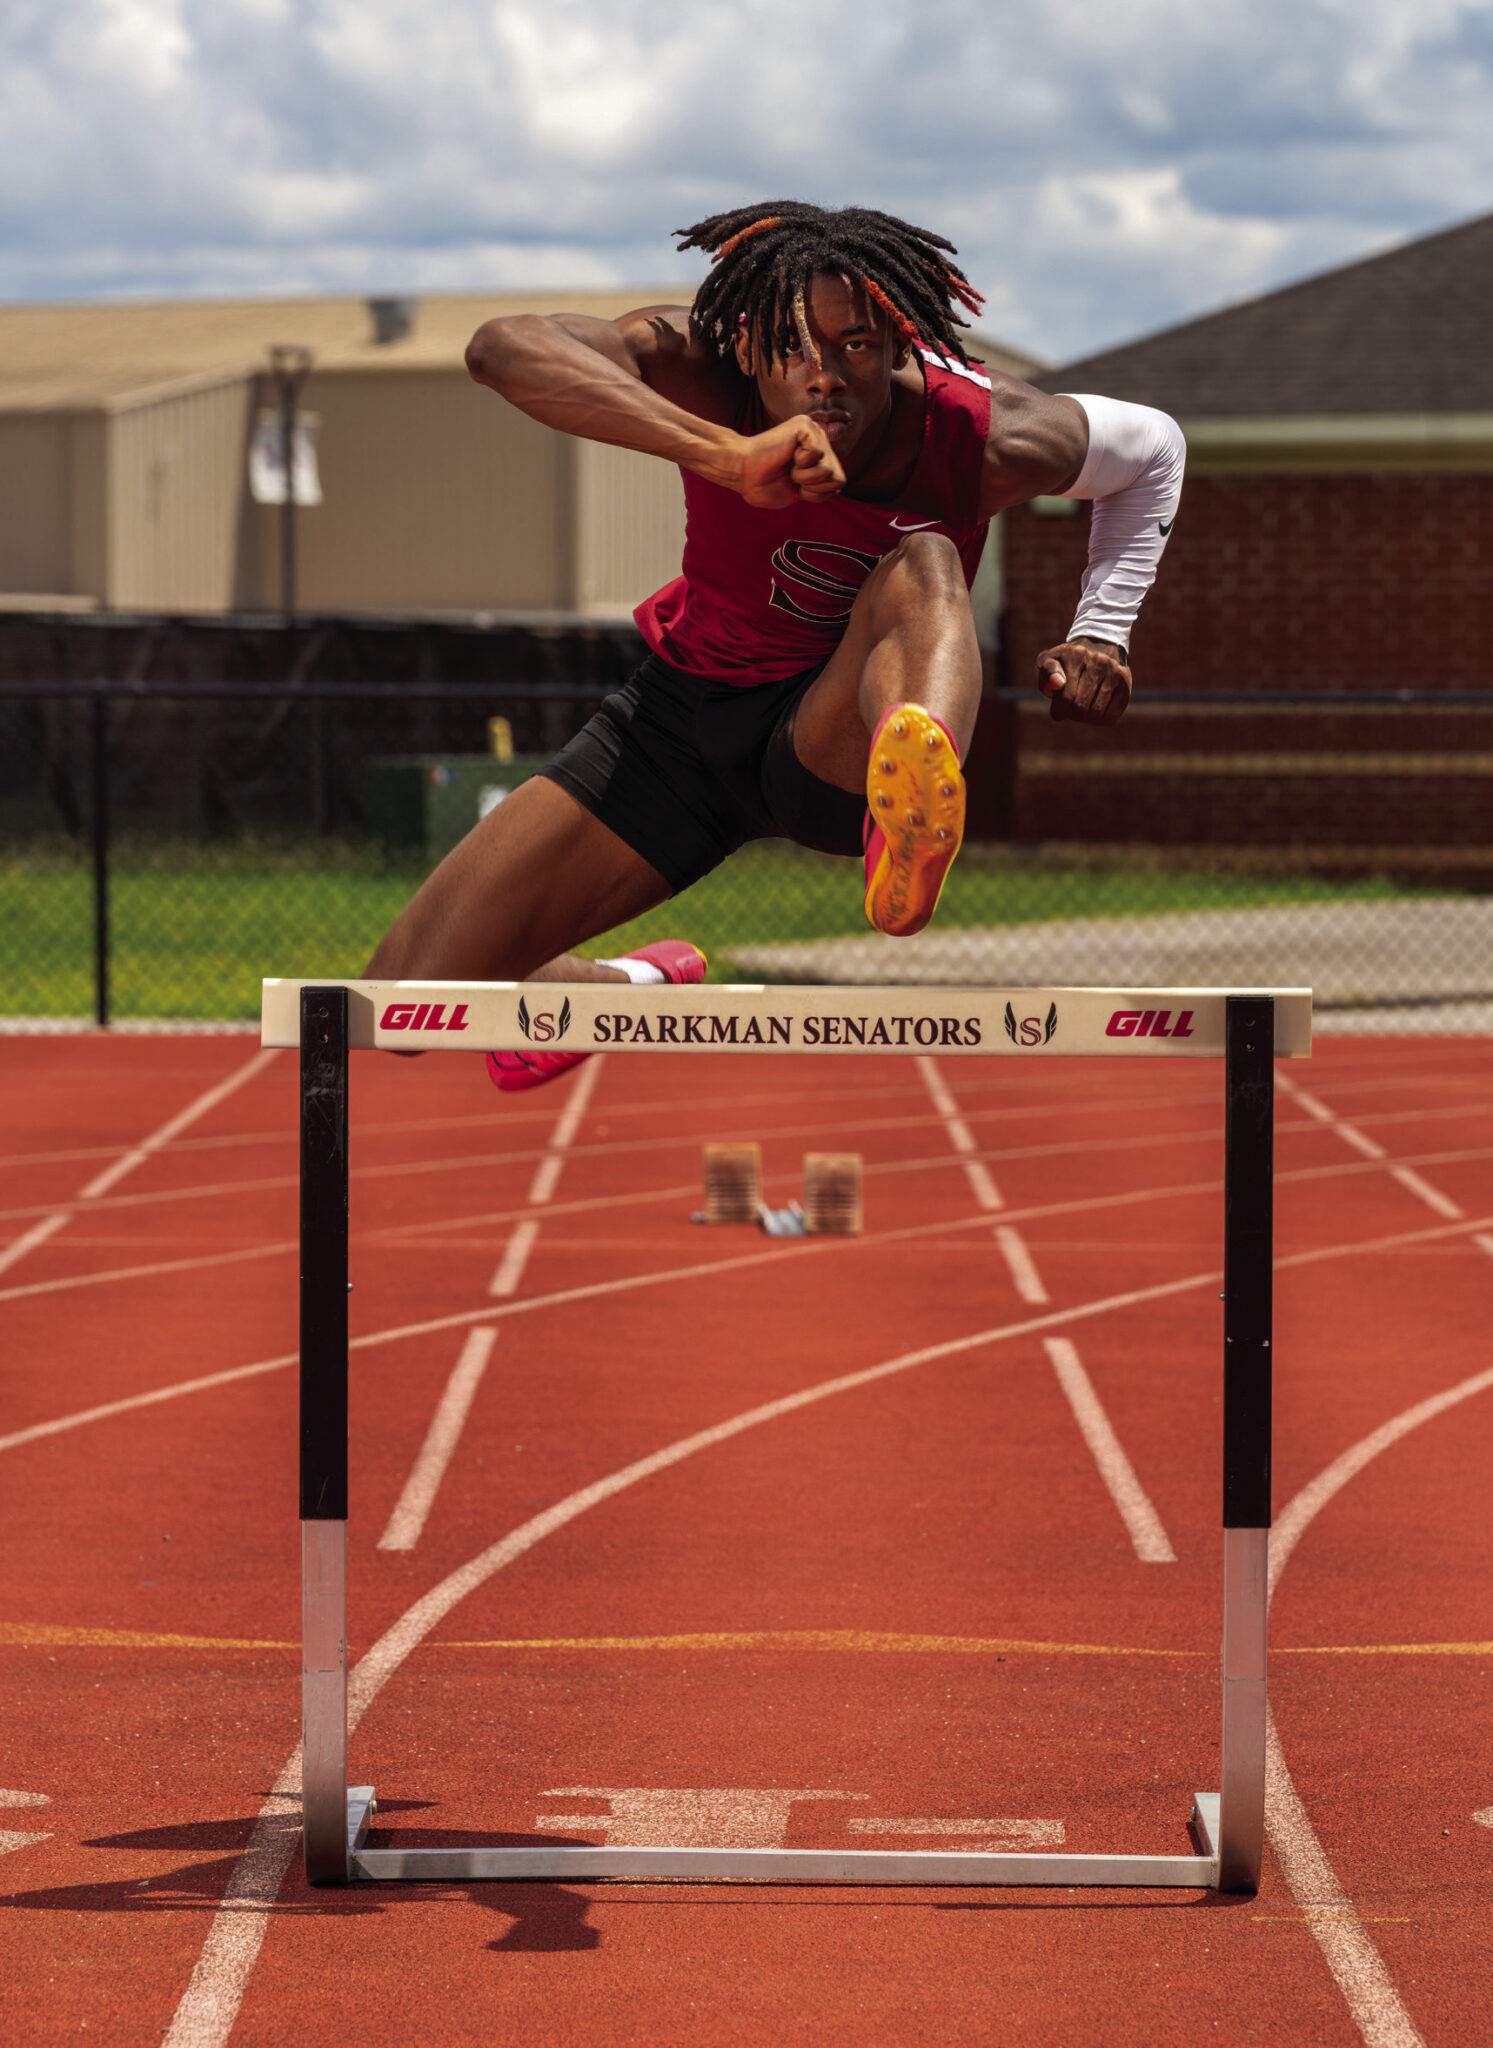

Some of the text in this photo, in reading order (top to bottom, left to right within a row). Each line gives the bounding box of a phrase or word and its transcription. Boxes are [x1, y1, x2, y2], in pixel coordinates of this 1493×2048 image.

[380, 1003, 469, 1031] GILL
[533, 1012, 556, 1043] S
[593, 1014, 982, 1046] SPARKMAN SENATORS
[1019, 1016, 1042, 1046] S
[1104, 1009, 1196, 1038] GILL
